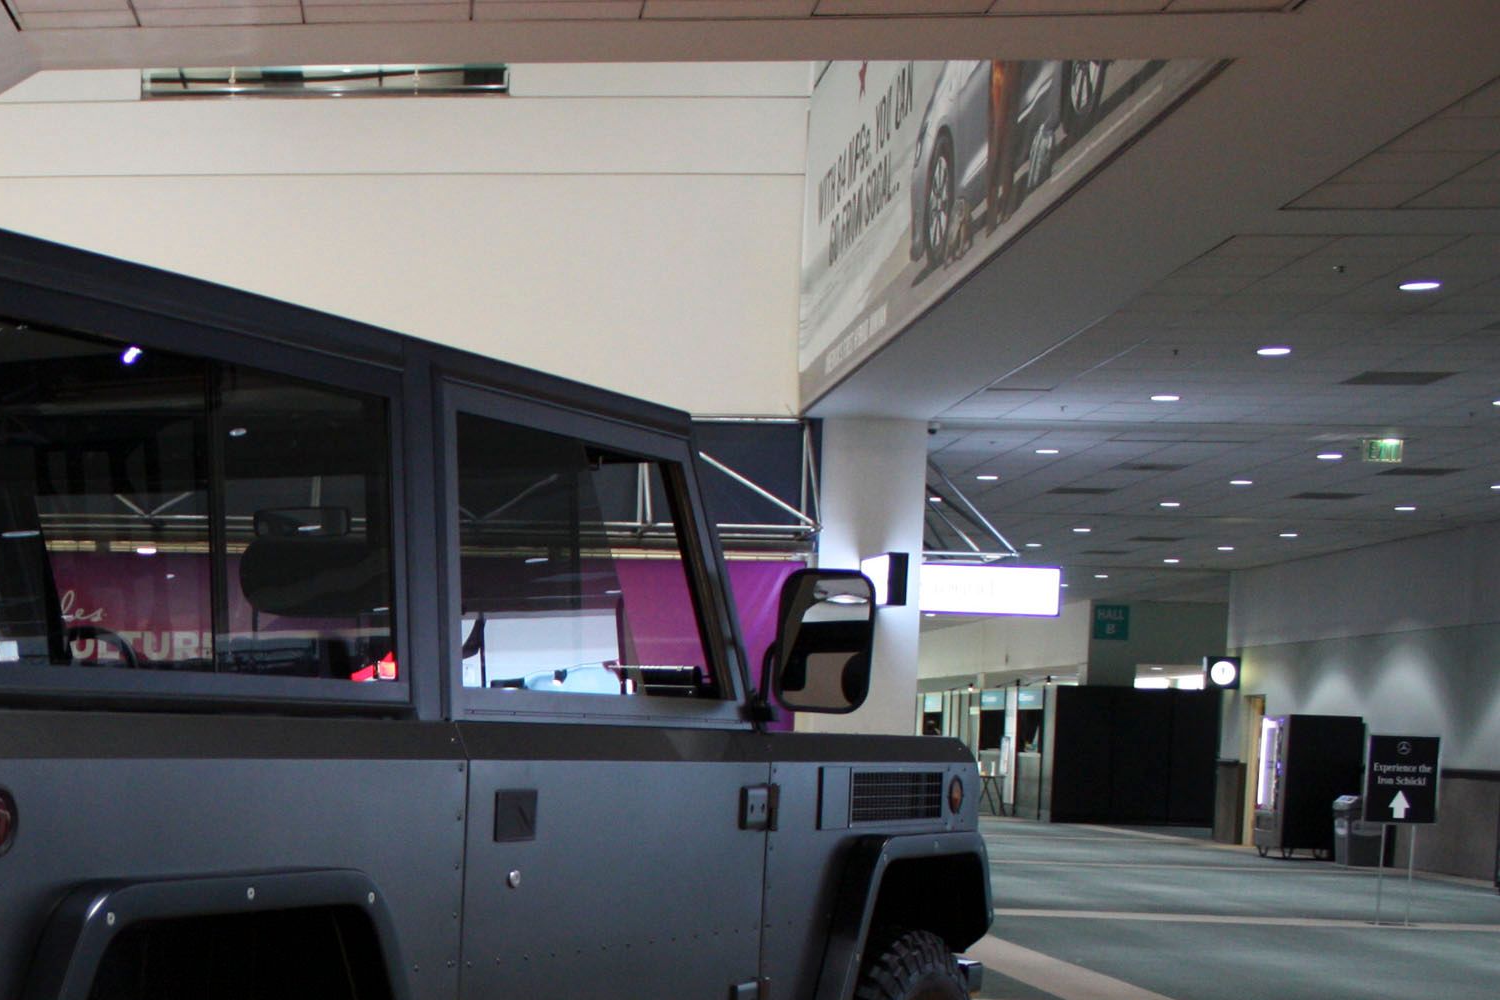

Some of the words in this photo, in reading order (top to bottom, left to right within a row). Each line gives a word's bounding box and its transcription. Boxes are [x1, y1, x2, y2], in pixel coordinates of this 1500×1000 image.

[875, 85, 893, 154] YOU
[895, 61, 914, 131] CAN
[60, 590, 107, 622] les
[1097, 607, 1125, 621] HALL
[1373, 762, 1417, 773] Experience
[1418, 763, 1433, 773] the
